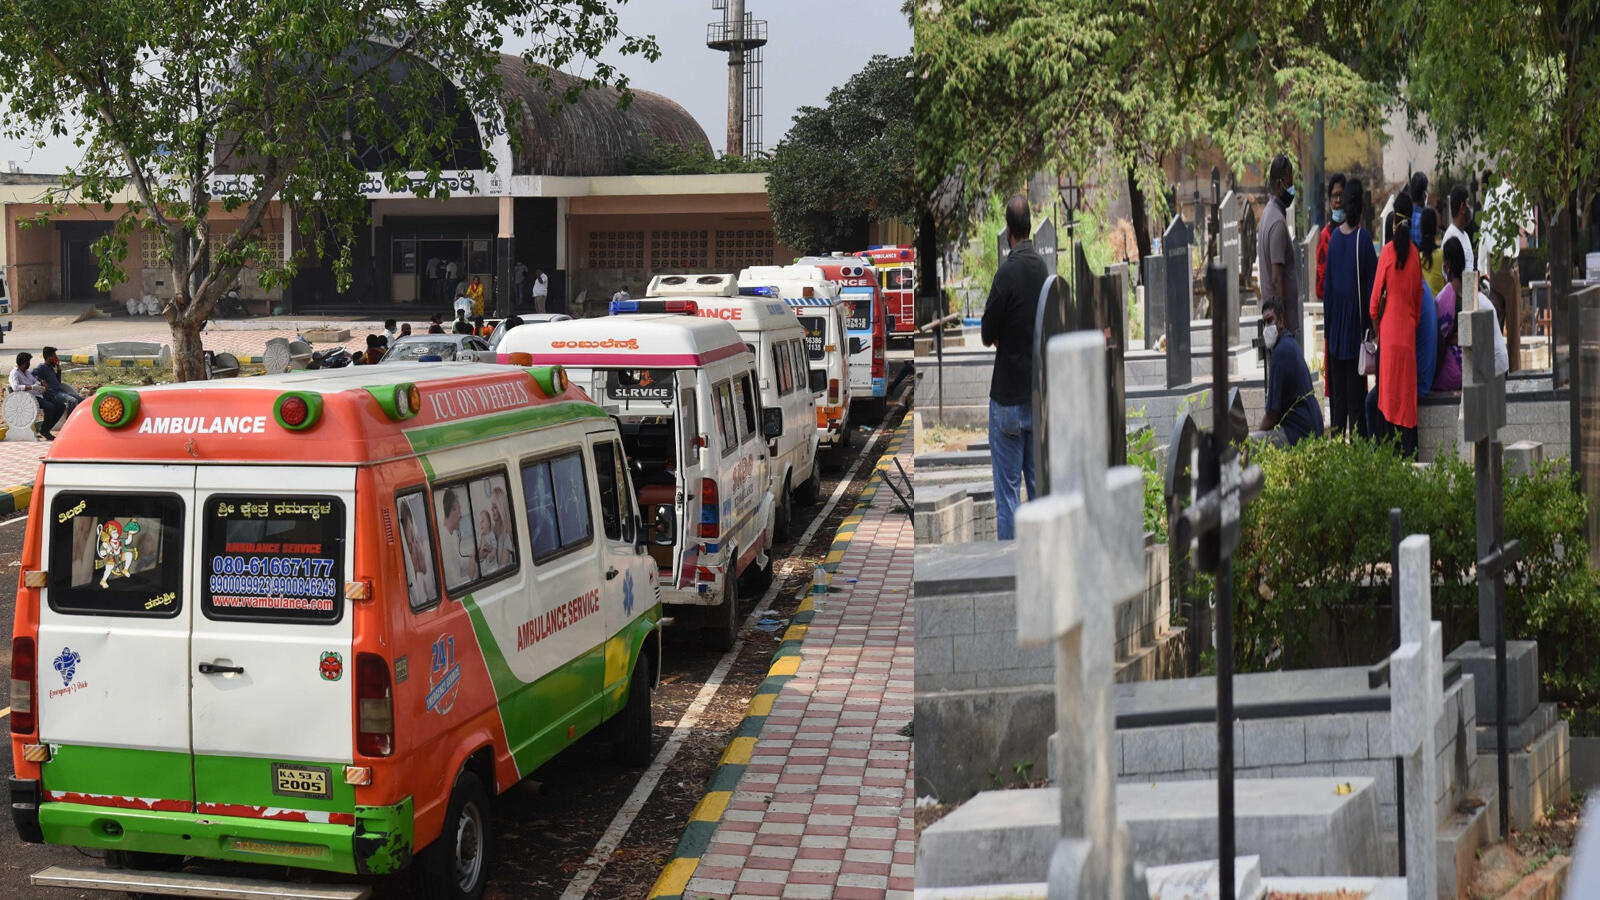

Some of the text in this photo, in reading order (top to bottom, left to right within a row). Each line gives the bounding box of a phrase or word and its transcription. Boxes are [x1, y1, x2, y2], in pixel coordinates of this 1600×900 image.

[428, 380, 529, 420] ICU ON WHEELS
[138, 416, 267, 434] AMBULANCE
[225, 542, 322, 555] AMBULANCE SERVICE
[212, 556, 334, 577] 080-61667177
[212, 594, 333, 611] www.vvambulance.com
[517, 588, 600, 653] AMBULANCE SERVICE
[279, 770, 296, 779] KA
[298, 772, 312, 780] 53
[279, 779, 322, 792] 2005
